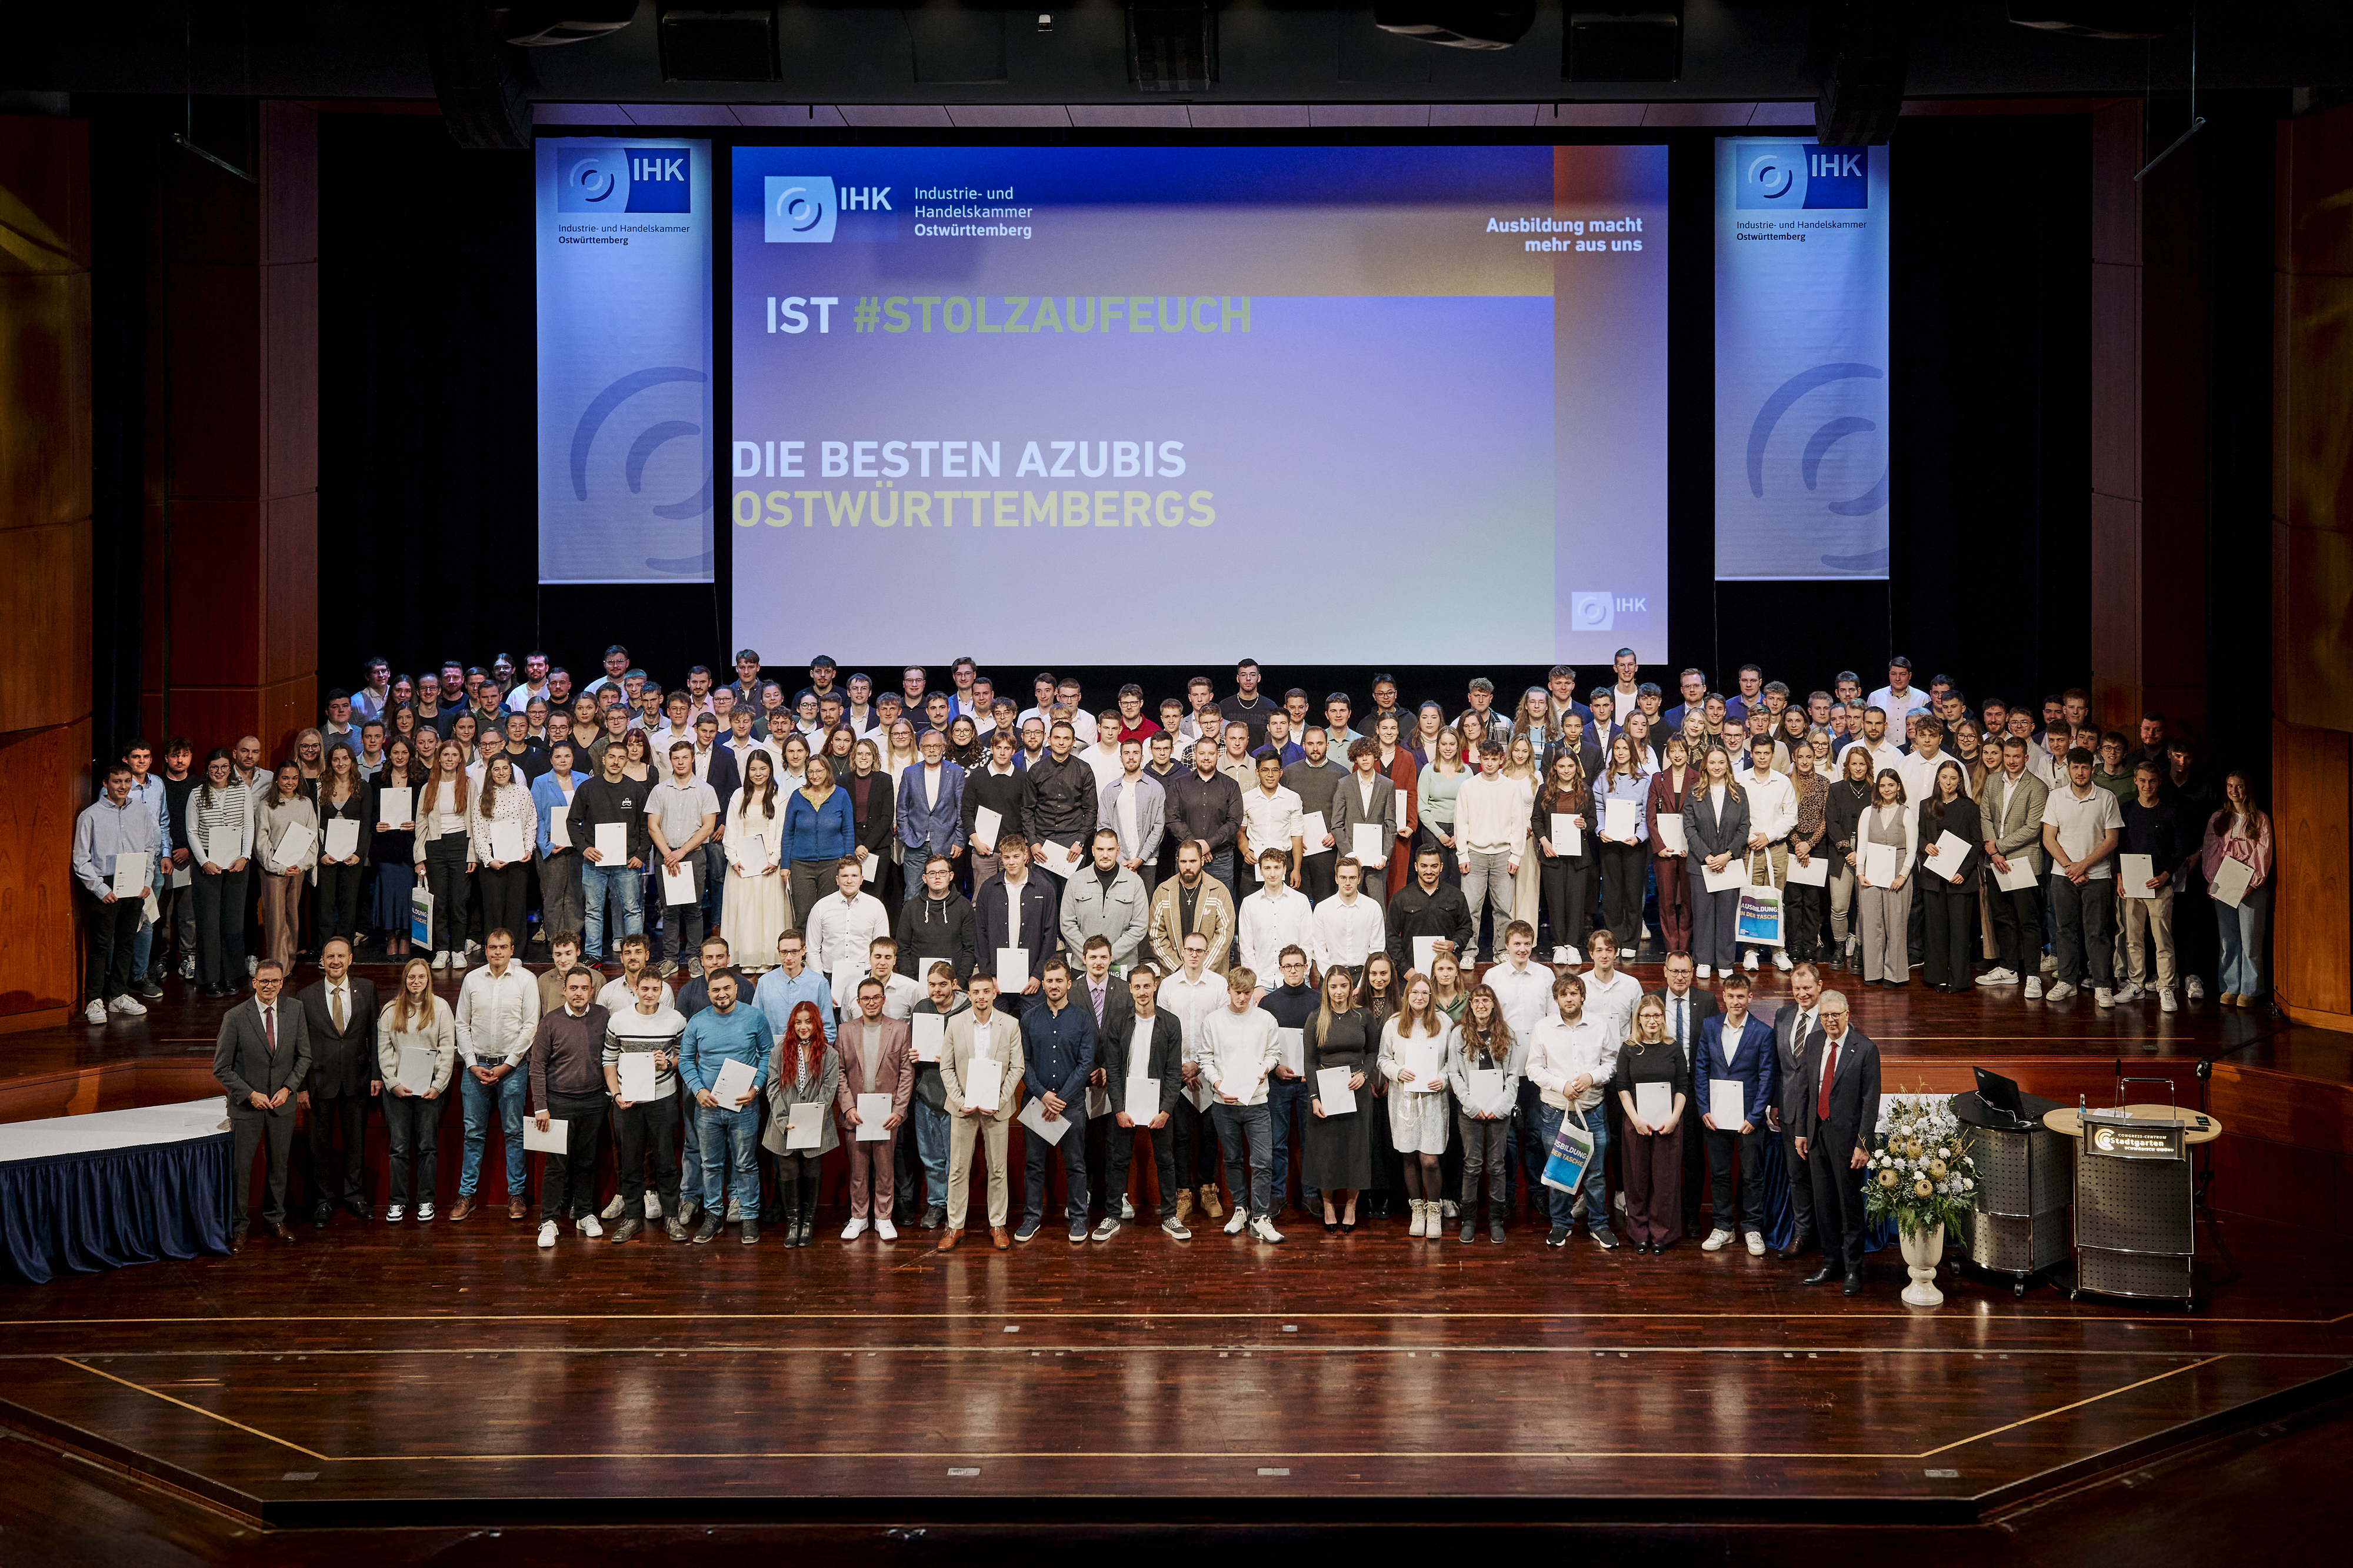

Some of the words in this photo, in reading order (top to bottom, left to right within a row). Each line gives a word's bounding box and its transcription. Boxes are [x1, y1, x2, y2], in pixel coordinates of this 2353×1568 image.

[634, 158, 685, 181] IHK
[1812, 154, 1862, 177] IHK
[841, 186, 892, 211] IHK
[915, 186, 982, 200] Industrie-
[986, 186, 1014, 200] und
[915, 205, 1032, 218] Handelskammer
[558, 224, 599, 232] Industrie-
[601, 224, 618, 232] und
[619, 224, 691, 233] Handelskammer
[914, 223, 1032, 239] Ostwürttemberg
[1486, 217, 1585, 236] Ausbildung
[1589, 216, 1643, 232] macht
[1737, 221, 1777, 229] Industrie-
[1779, 221, 1795, 229] und
[1797, 220, 1867, 229] Handelskammer
[558, 236, 629, 246] Ostwürttemberg
[1525, 236, 1571, 252] mehr
[1575, 239, 1607, 252] aus
[1611, 239, 1643, 252] uns
[1737, 232, 1806, 242] Ostwürttemberg
[766, 296, 839, 334] IST
[853, 295, 1251, 333] #STOLZAUFEUCH
[732, 441, 805, 478] DIE
[821, 440, 1001, 478] BESTEN
[1015, 440, 1187, 478] AZUBIS
[733, 480, 1217, 528] OSTWÜRTTEMBERGS
[1616, 598, 1647, 612] IHK
[2110, 1137, 2164, 1147] Stadtgarten
